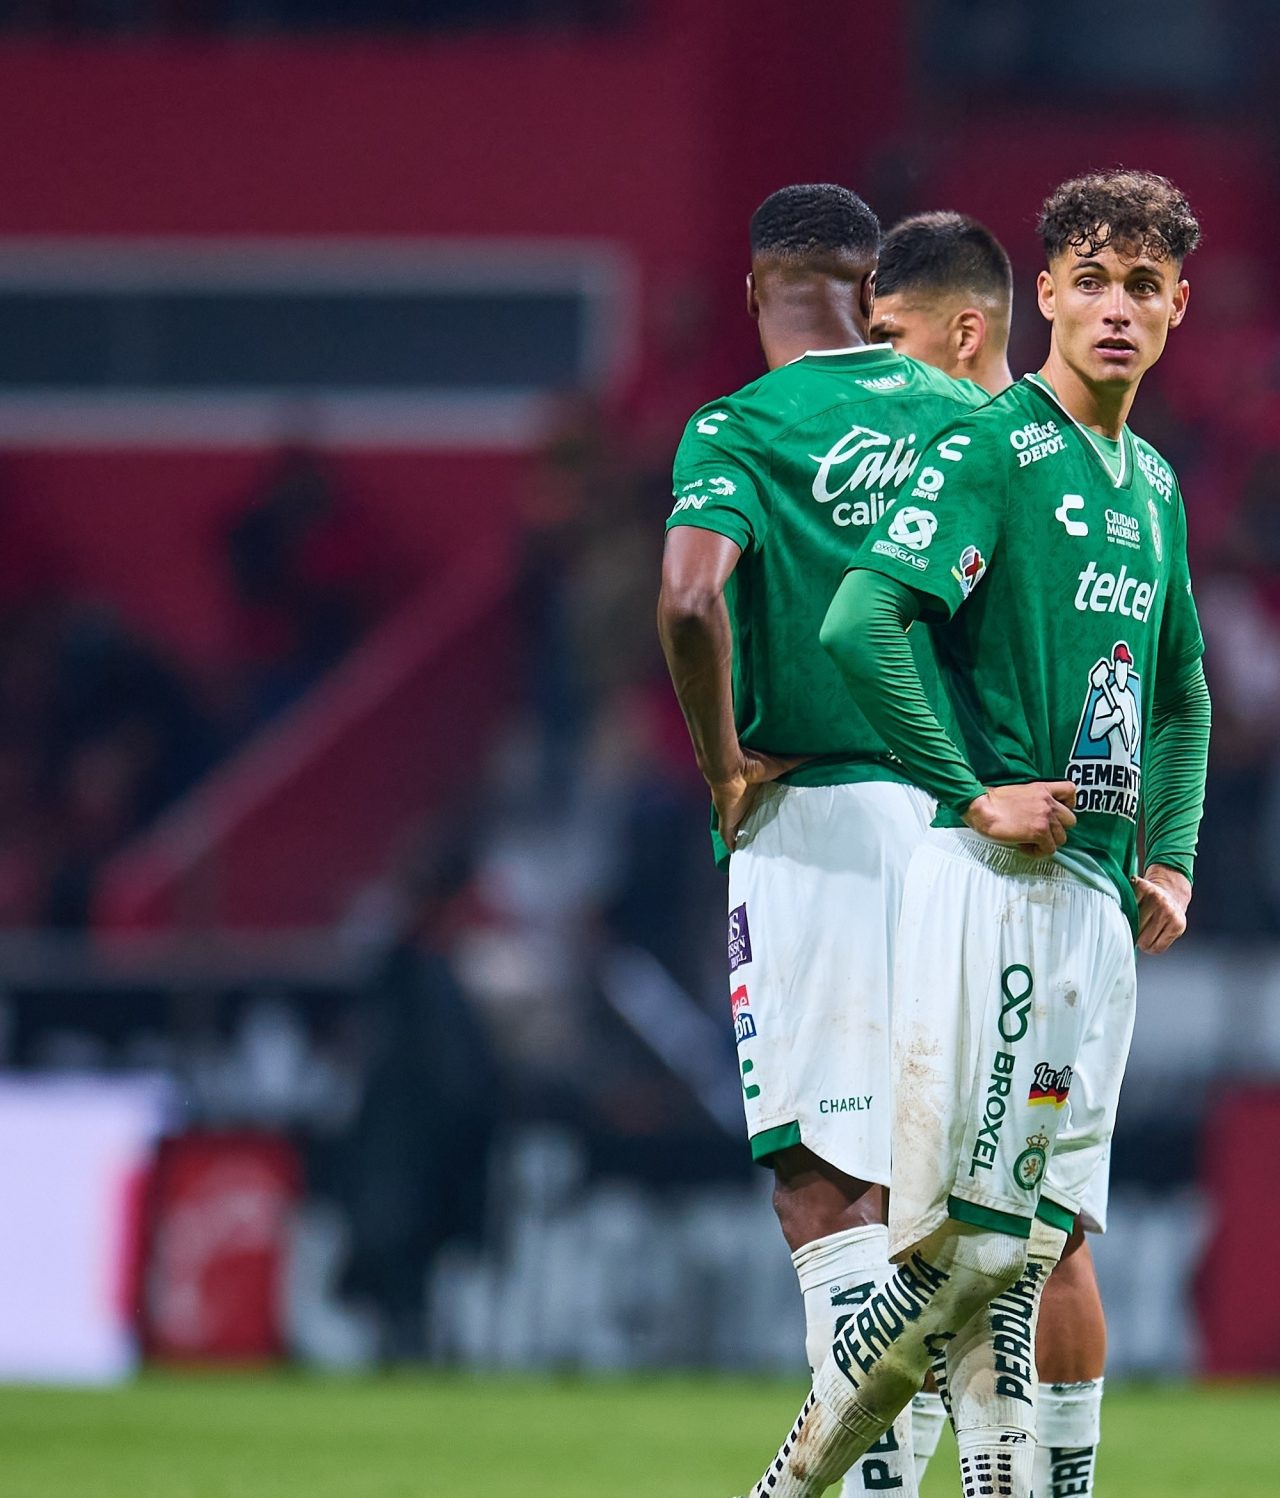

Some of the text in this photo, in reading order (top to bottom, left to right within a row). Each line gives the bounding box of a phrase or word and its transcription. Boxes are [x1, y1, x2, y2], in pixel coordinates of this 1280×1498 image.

[1010, 420, 1059, 450] Office
[1016, 434, 1066, 468] DEPOT
[911, 487, 939, 502] Berel
[1105, 508, 1139, 531] CIUDAD
[1106, 522, 1140, 543] MADERAS
[1074, 561, 1159, 624] telcel
[1067, 764, 1141, 792] CEMENT
[1075, 789, 1137, 819] ORTALE
[819, 1096, 873, 1114] CHARLY
[968, 1051, 1016, 1178] BROXEL
[832, 1257, 950, 1390] PERDURA
